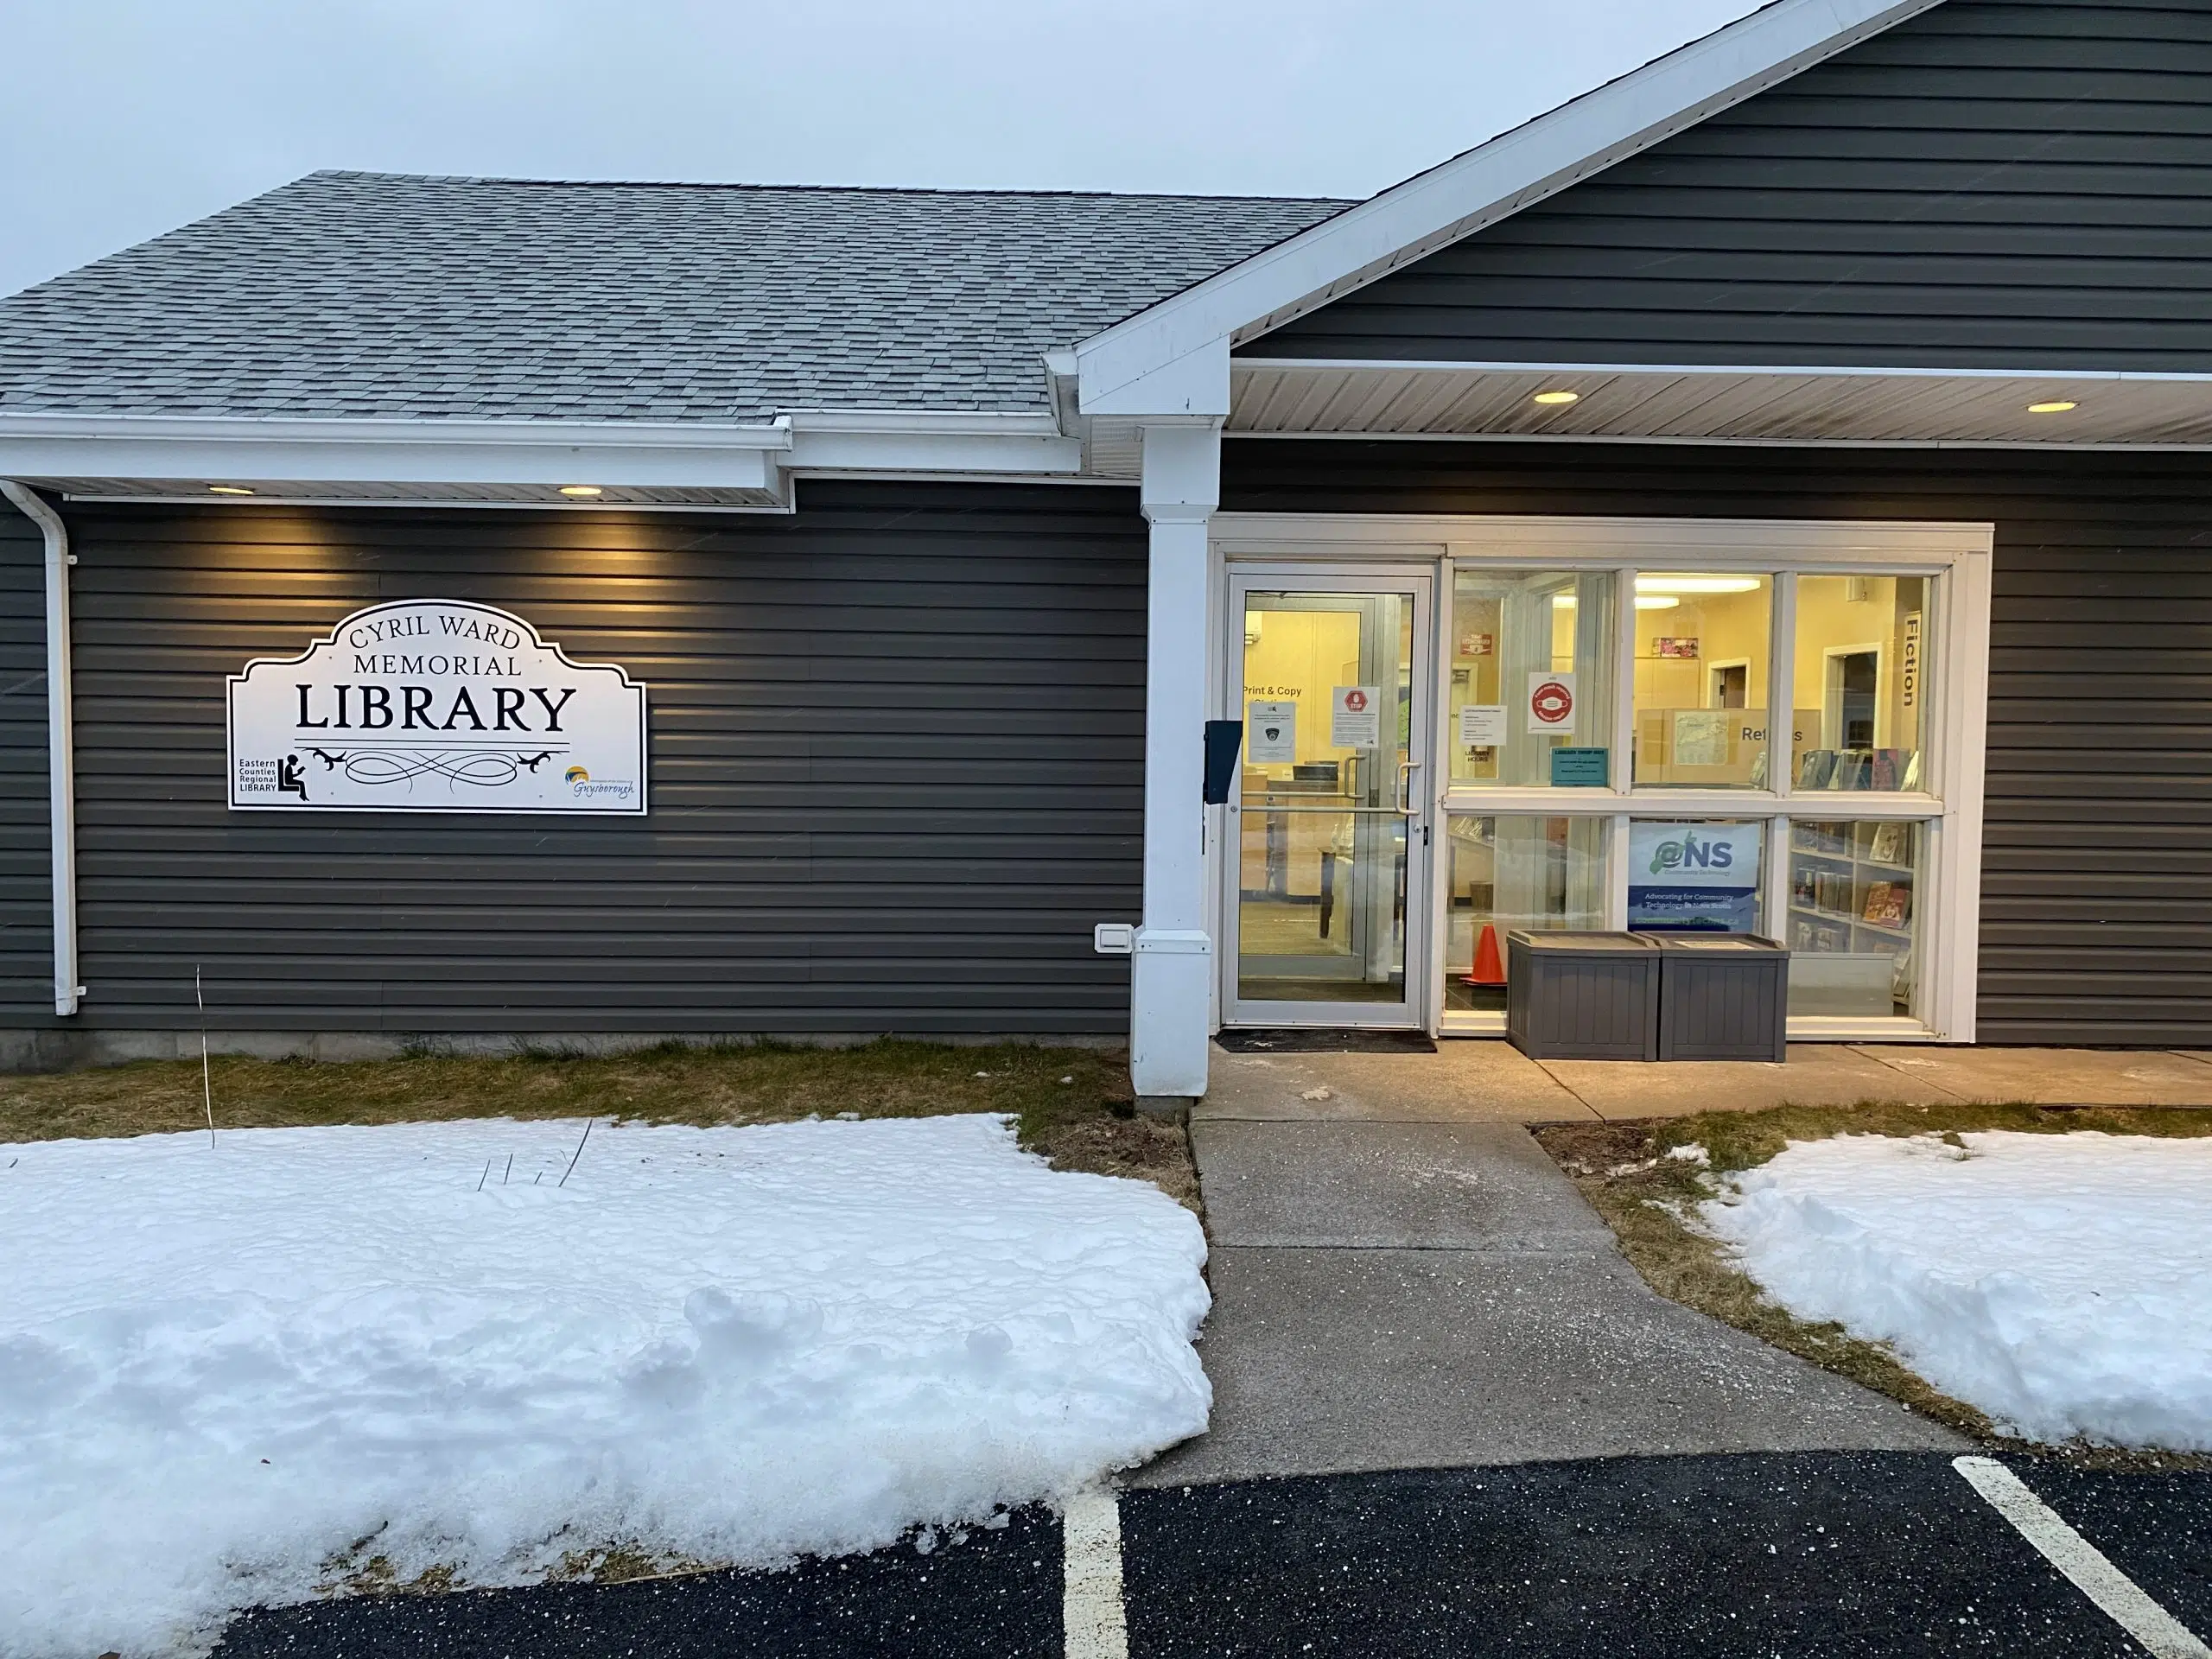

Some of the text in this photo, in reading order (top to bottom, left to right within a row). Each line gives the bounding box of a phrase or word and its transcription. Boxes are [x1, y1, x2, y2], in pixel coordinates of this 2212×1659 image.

[349, 615, 521, 649] CYRIL WARD
[353, 654, 522, 676] MEMORIAL
[1904, 619, 1918, 707] Fiction
[1243, 685, 1302, 697] Print & Copy
[296, 683, 577, 732] LIBRARY
[239, 759, 276, 767] Eastern
[239, 775, 276, 784] Regional
[574, 780, 635, 799] Guysborough
[1694, 893, 1734, 902] Community
[1645, 901, 1683, 910] Technology
